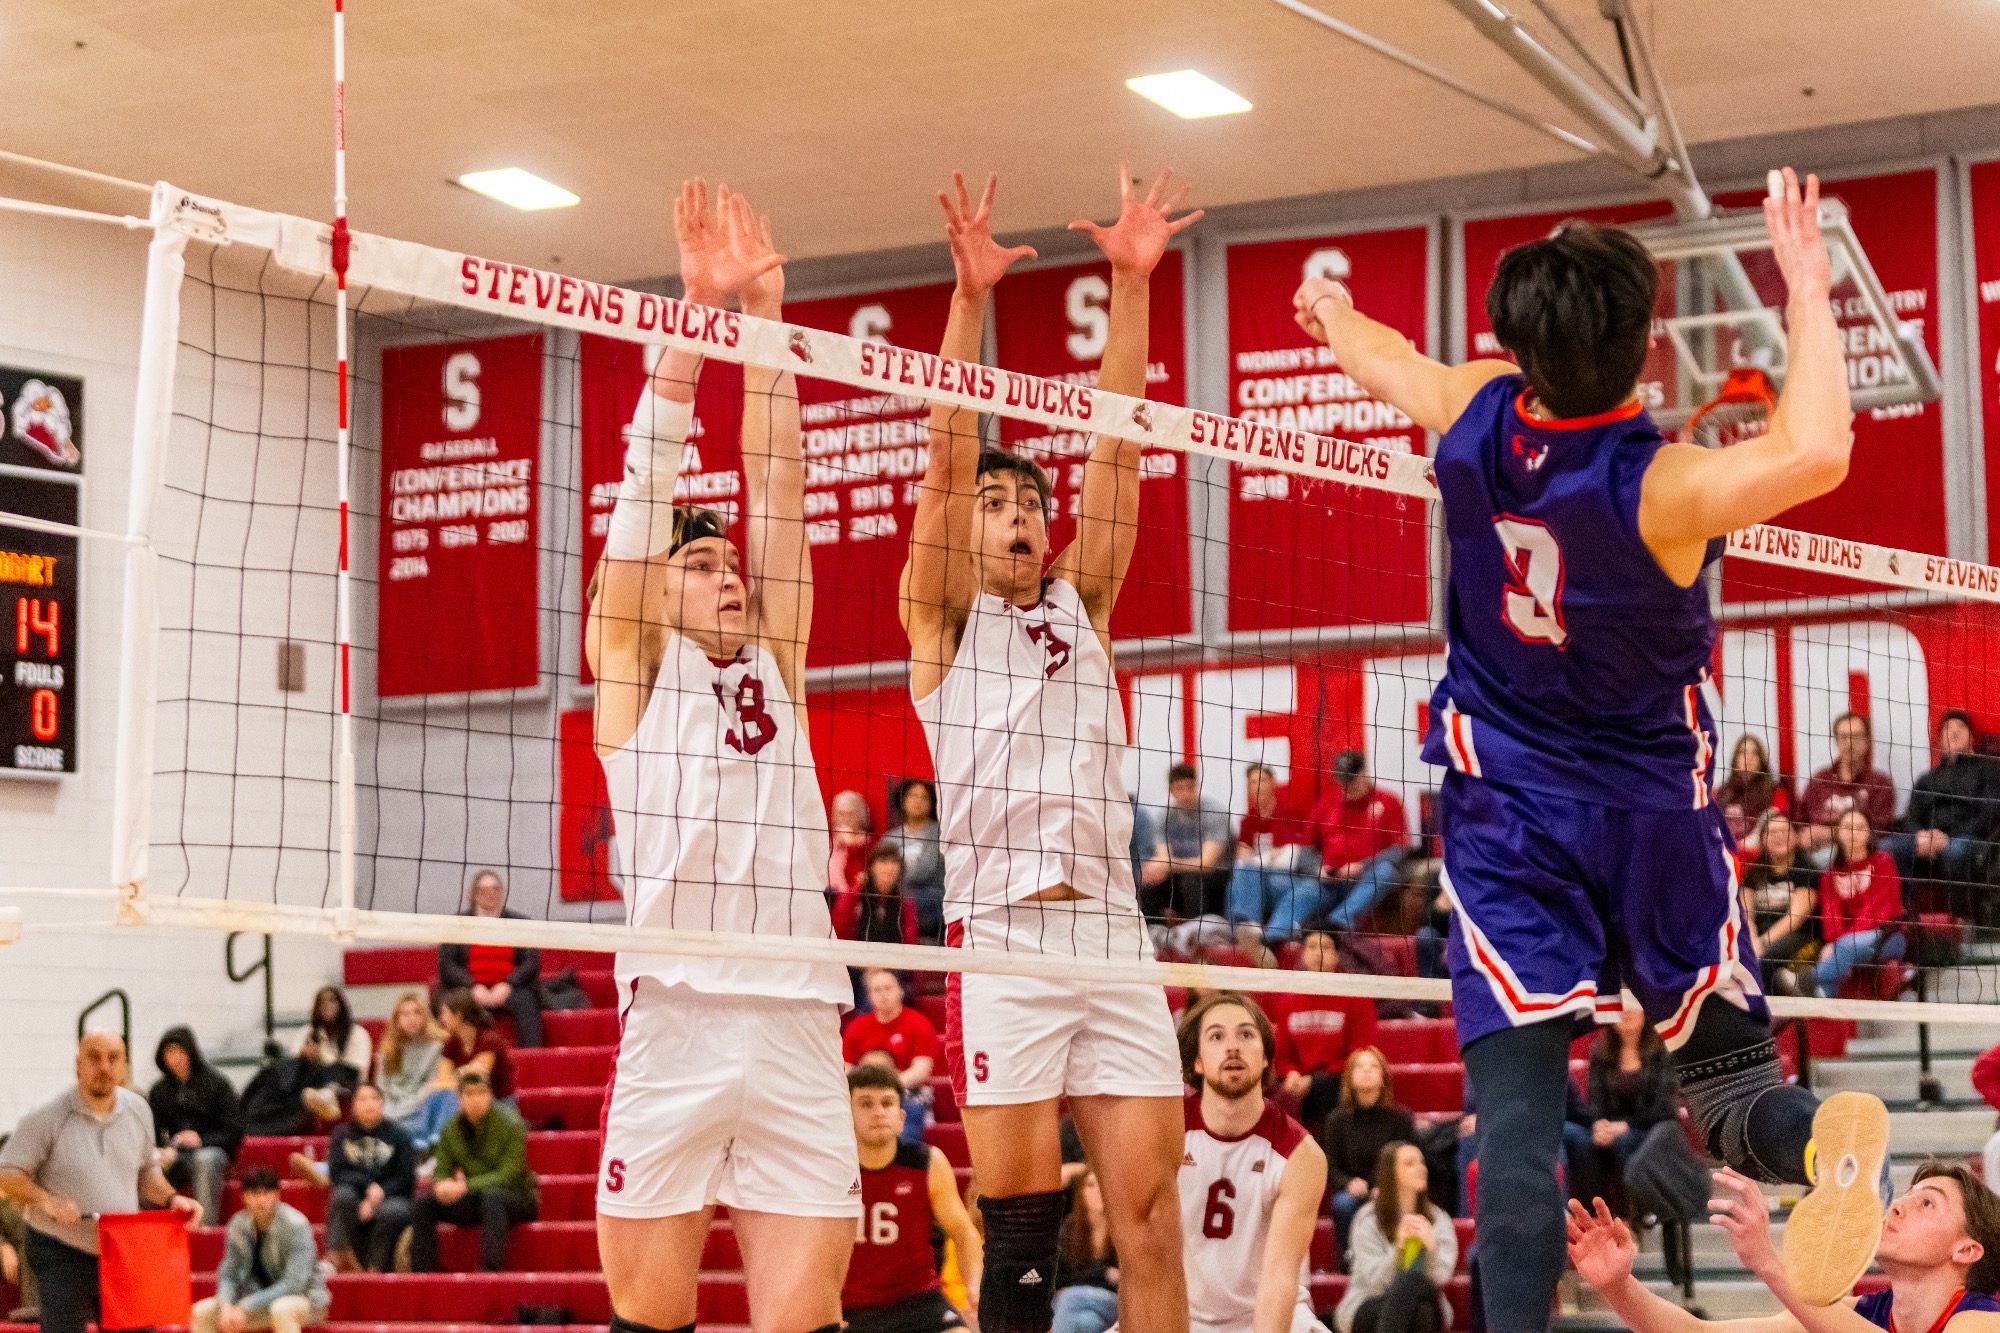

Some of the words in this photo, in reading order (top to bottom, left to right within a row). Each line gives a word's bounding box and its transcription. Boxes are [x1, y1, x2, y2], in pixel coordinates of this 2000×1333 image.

[460, 256, 625, 325] STEVENS
[636, 292, 742, 348] DUCKS
[441, 352, 482, 432] S
[860, 341, 996, 400] STEVENS
[1005, 372, 1093, 421] DUCKS
[1190, 411, 1306, 464] STEVENS
[1315, 437, 1391, 480] DUCKS
[390, 458, 531, 496] CONFERENCE
[390, 486, 530, 523] CHAMPIONS
[1726, 525, 1802, 559] TEVENS
[1807, 534, 1863, 570] DUCKS
[1924, 557, 2000, 593] STEVENS
[17, 597, 59, 656] 14
[15, 661, 64, 690] FOULS
[32, 688, 58, 741] 0
[15, 744, 64, 771] SCORE
[973, 1051, 990, 1083] S
[606, 1157, 627, 1194] S
[1203, 1177, 1236, 1239] 6
